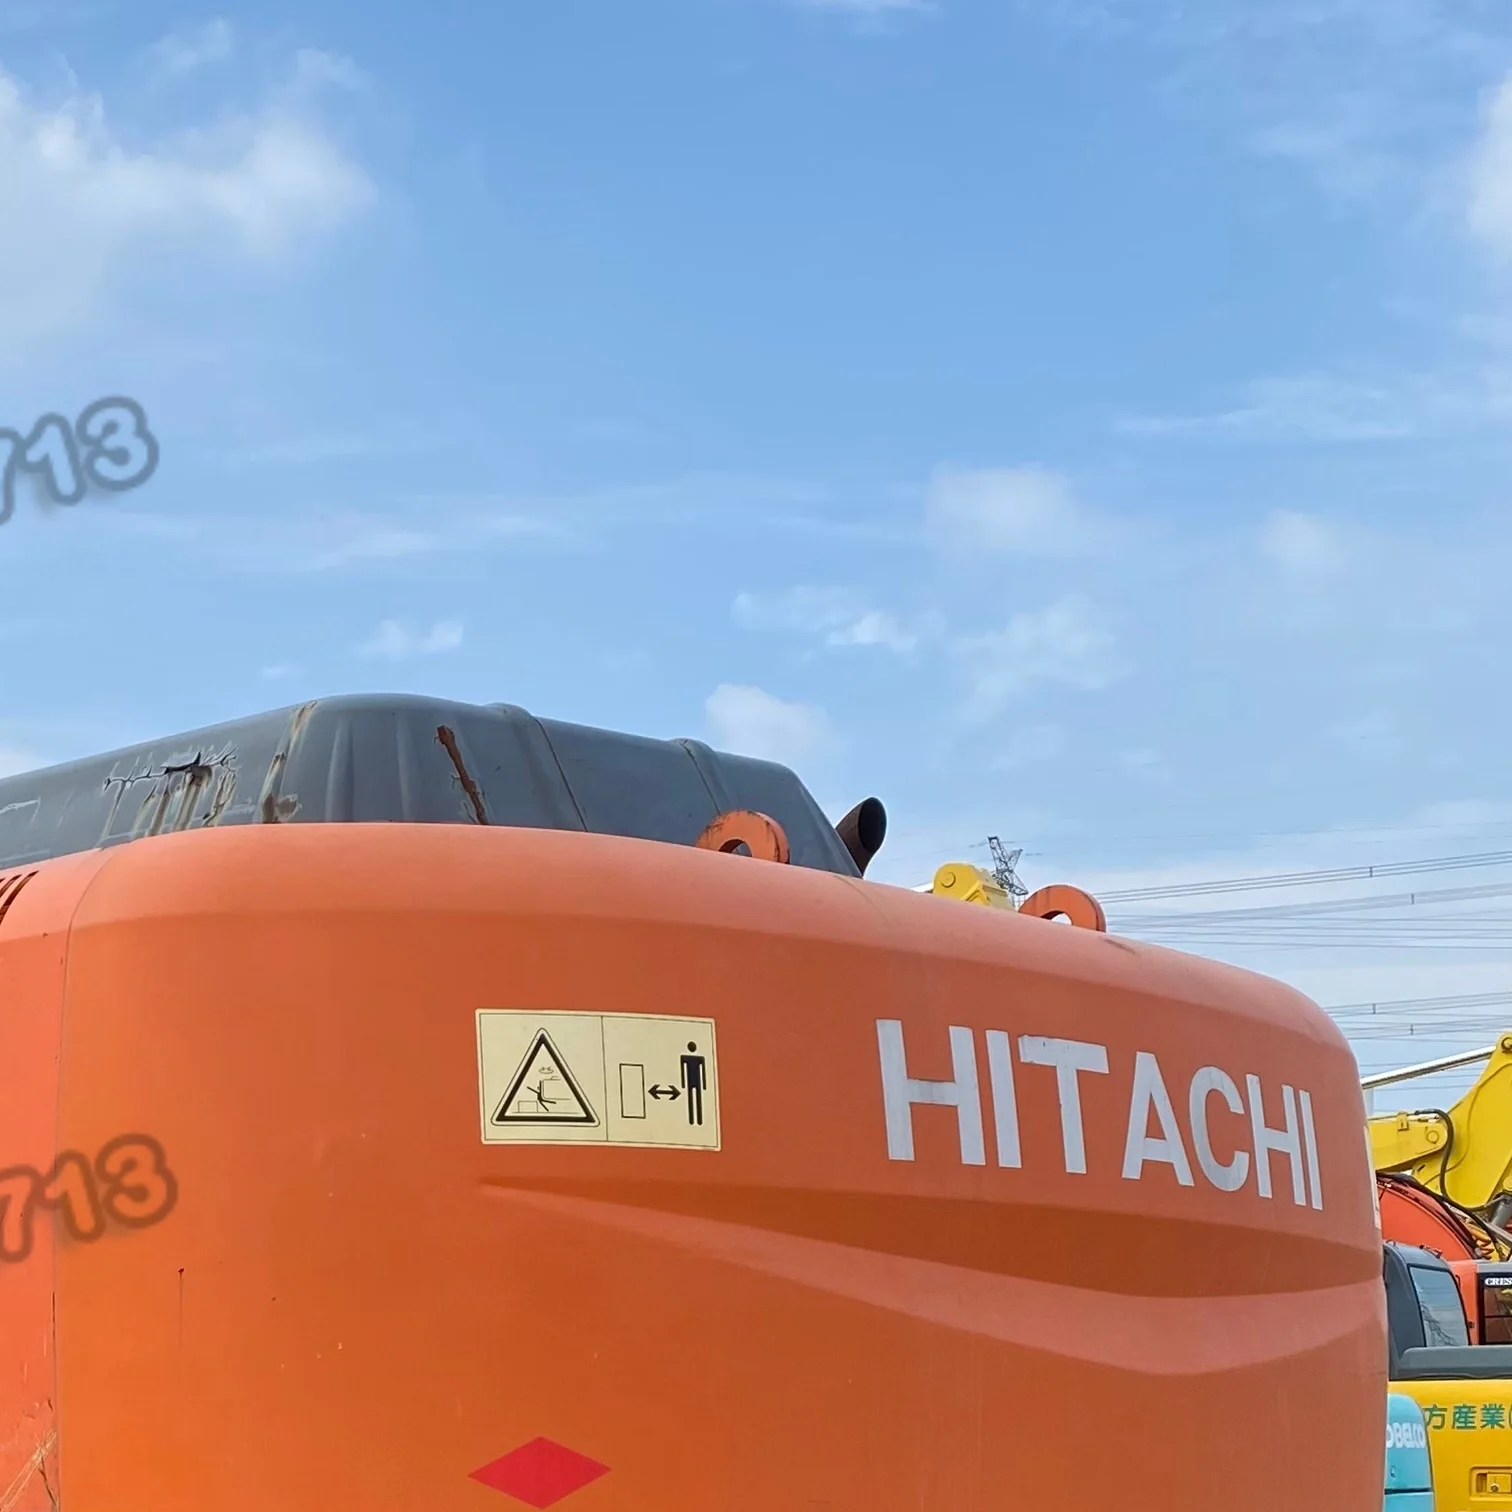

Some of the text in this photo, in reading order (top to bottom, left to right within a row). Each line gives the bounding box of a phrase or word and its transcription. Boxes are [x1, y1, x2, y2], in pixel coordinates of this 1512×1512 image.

[876, 1018, 1323, 1210] HITACHI
[1424, 1403, 1512, 1430] 方産業
